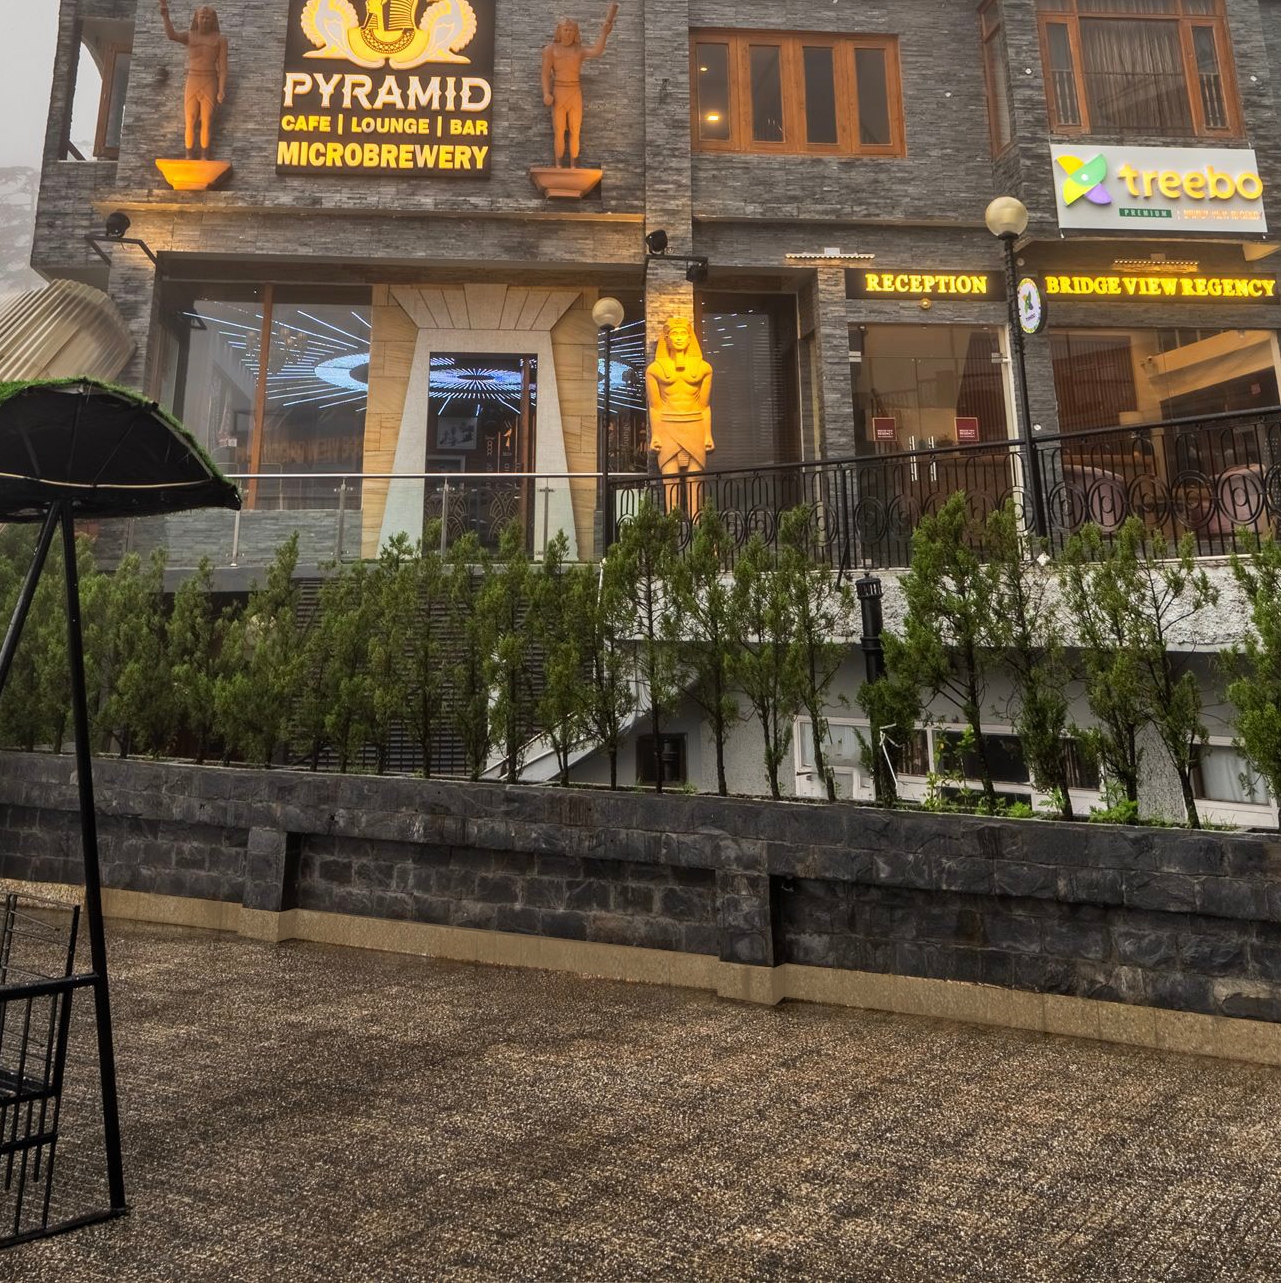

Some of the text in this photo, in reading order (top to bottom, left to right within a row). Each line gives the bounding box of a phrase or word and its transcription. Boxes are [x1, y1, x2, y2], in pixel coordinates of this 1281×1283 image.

[283, 72, 492, 112] PYRAMID
[281, 115, 488, 136] CAFE LOUNGE BAR
[277, 141, 489, 170] MICROBREWERY
[1118, 163, 1263, 200] treebo
[1124, 209, 1168, 217] PREMIUM
[865, 274, 987, 294] RECEPTION
[1045, 276, 1276, 297] BRIDGE VIEW REGENCY
